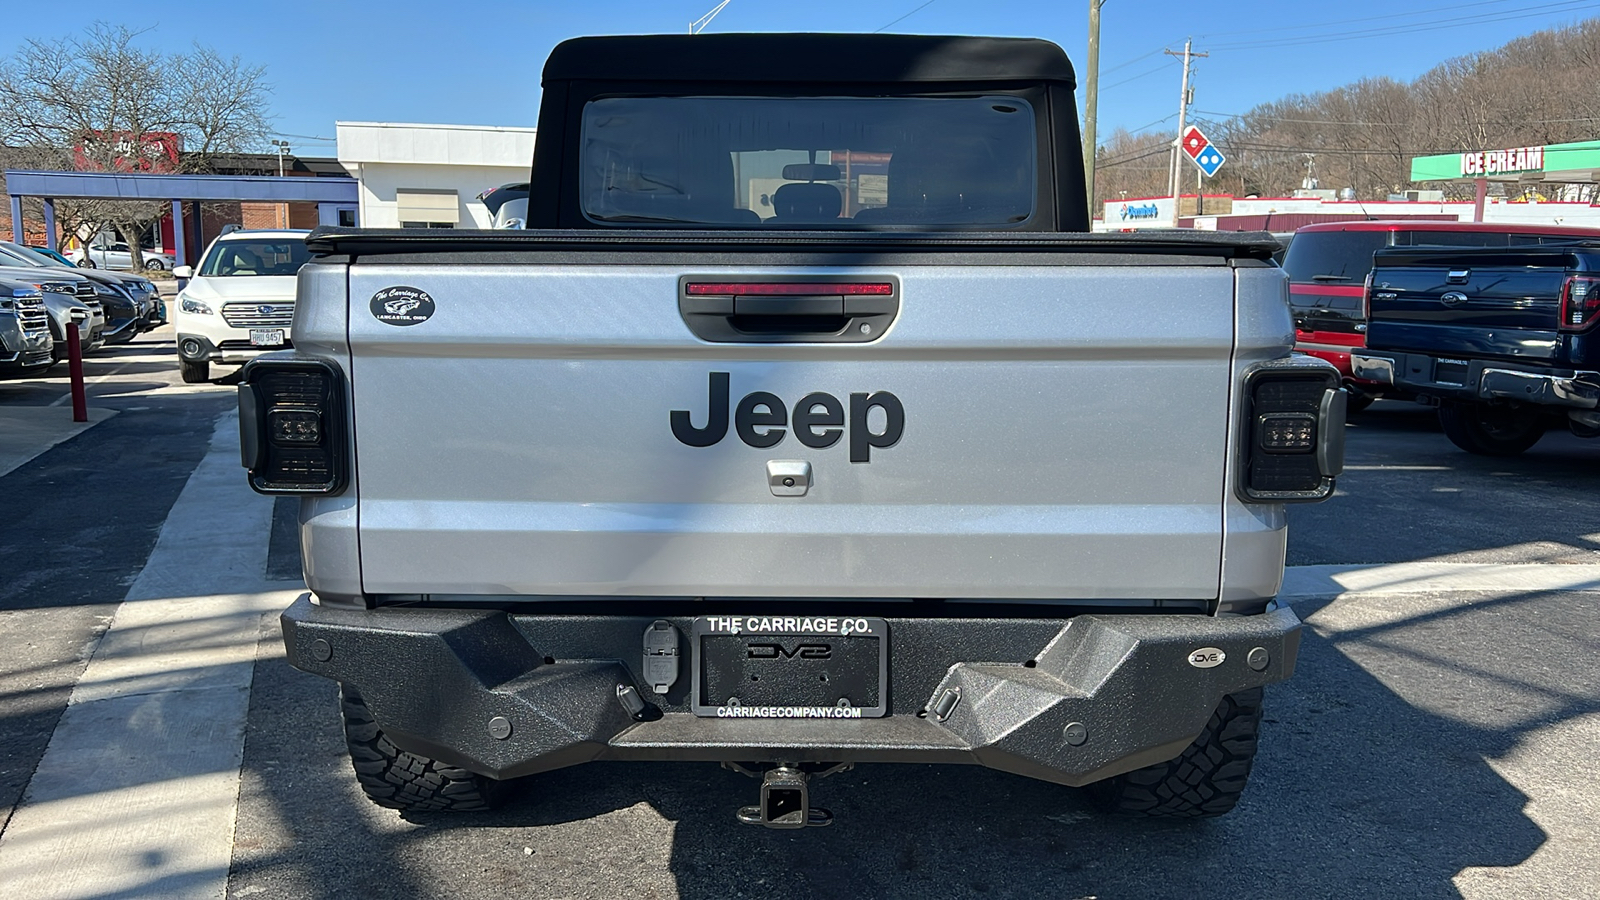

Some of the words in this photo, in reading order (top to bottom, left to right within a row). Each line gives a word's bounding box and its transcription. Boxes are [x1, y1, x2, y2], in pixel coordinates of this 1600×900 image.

[1461, 152, 1484, 175] ICE
[1486, 147, 1544, 175] CREAM
[375, 291, 388, 301] The
[388, 288, 419, 299] Carriage
[419, 292, 431, 303] Co.
[266, 332, 281, 342] 9457
[669, 371, 905, 464] Jeep
[707, 617, 742, 632] THE
[747, 617, 837, 633] CARRIAGE
[841, 618, 872, 633] CO.
[716, 706, 862, 718] CARRIAGECOMPANY.COM
